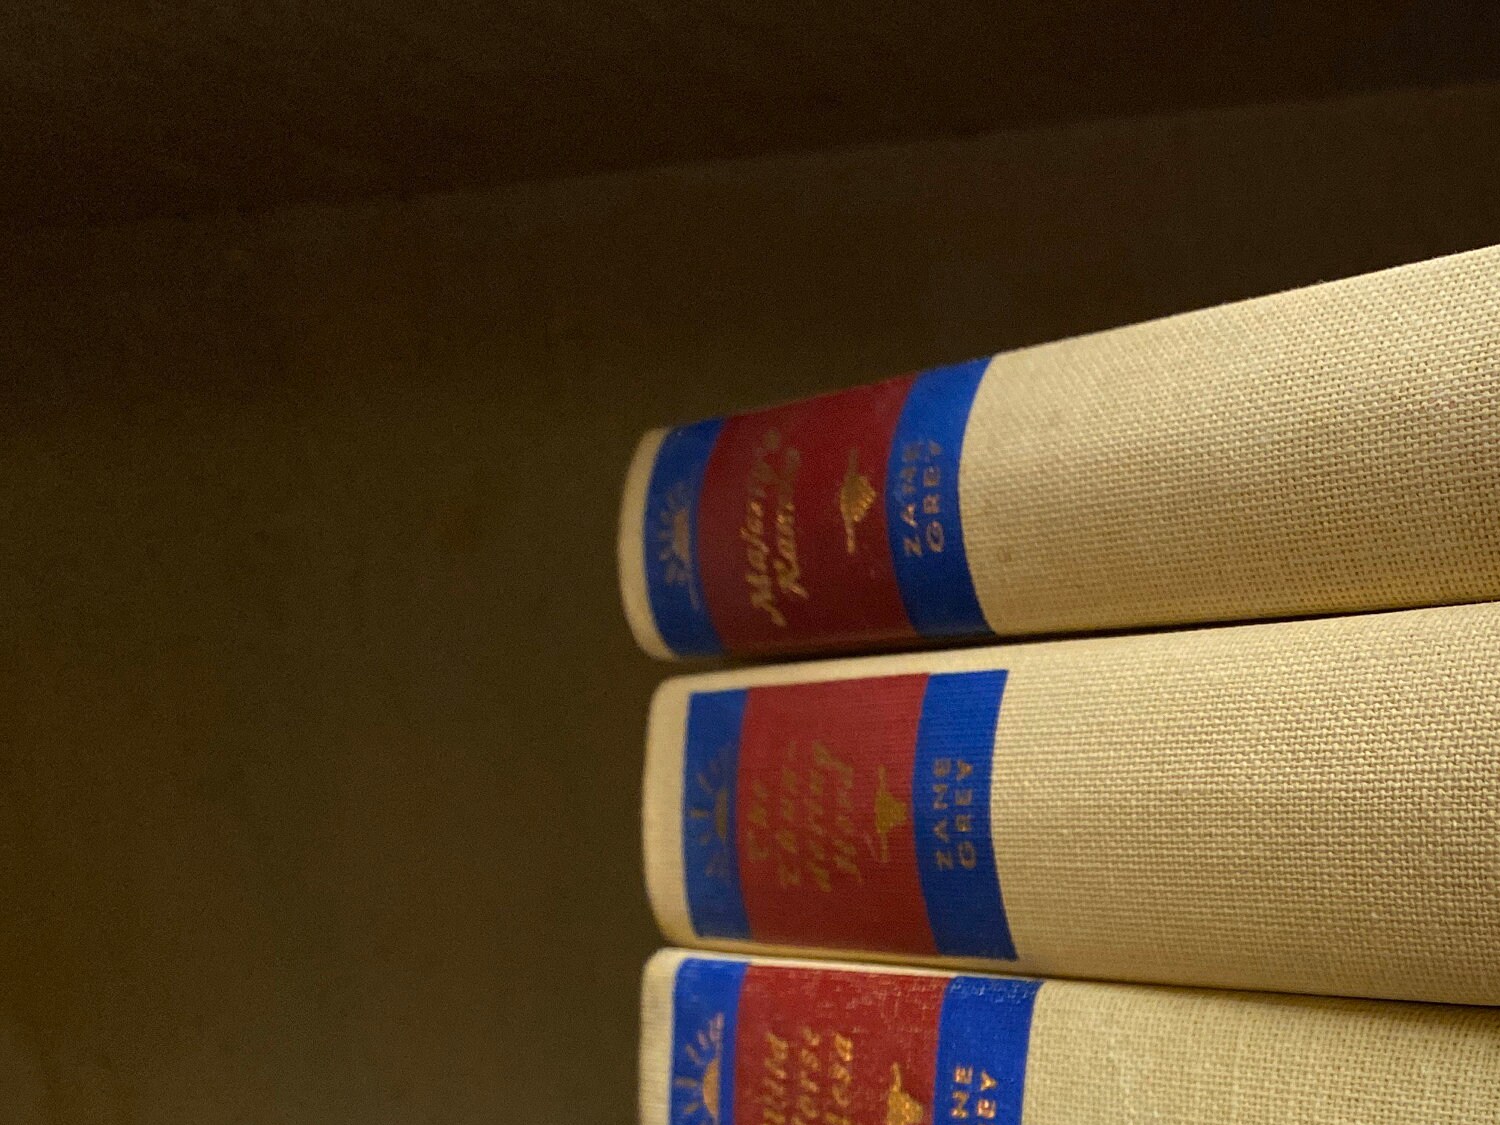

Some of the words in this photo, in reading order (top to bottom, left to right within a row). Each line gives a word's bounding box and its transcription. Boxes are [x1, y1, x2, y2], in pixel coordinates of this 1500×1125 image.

[922, 438, 946, 553] GREY
[932, 757, 953, 871] ZANE
[955, 757, 976, 870] GREY
